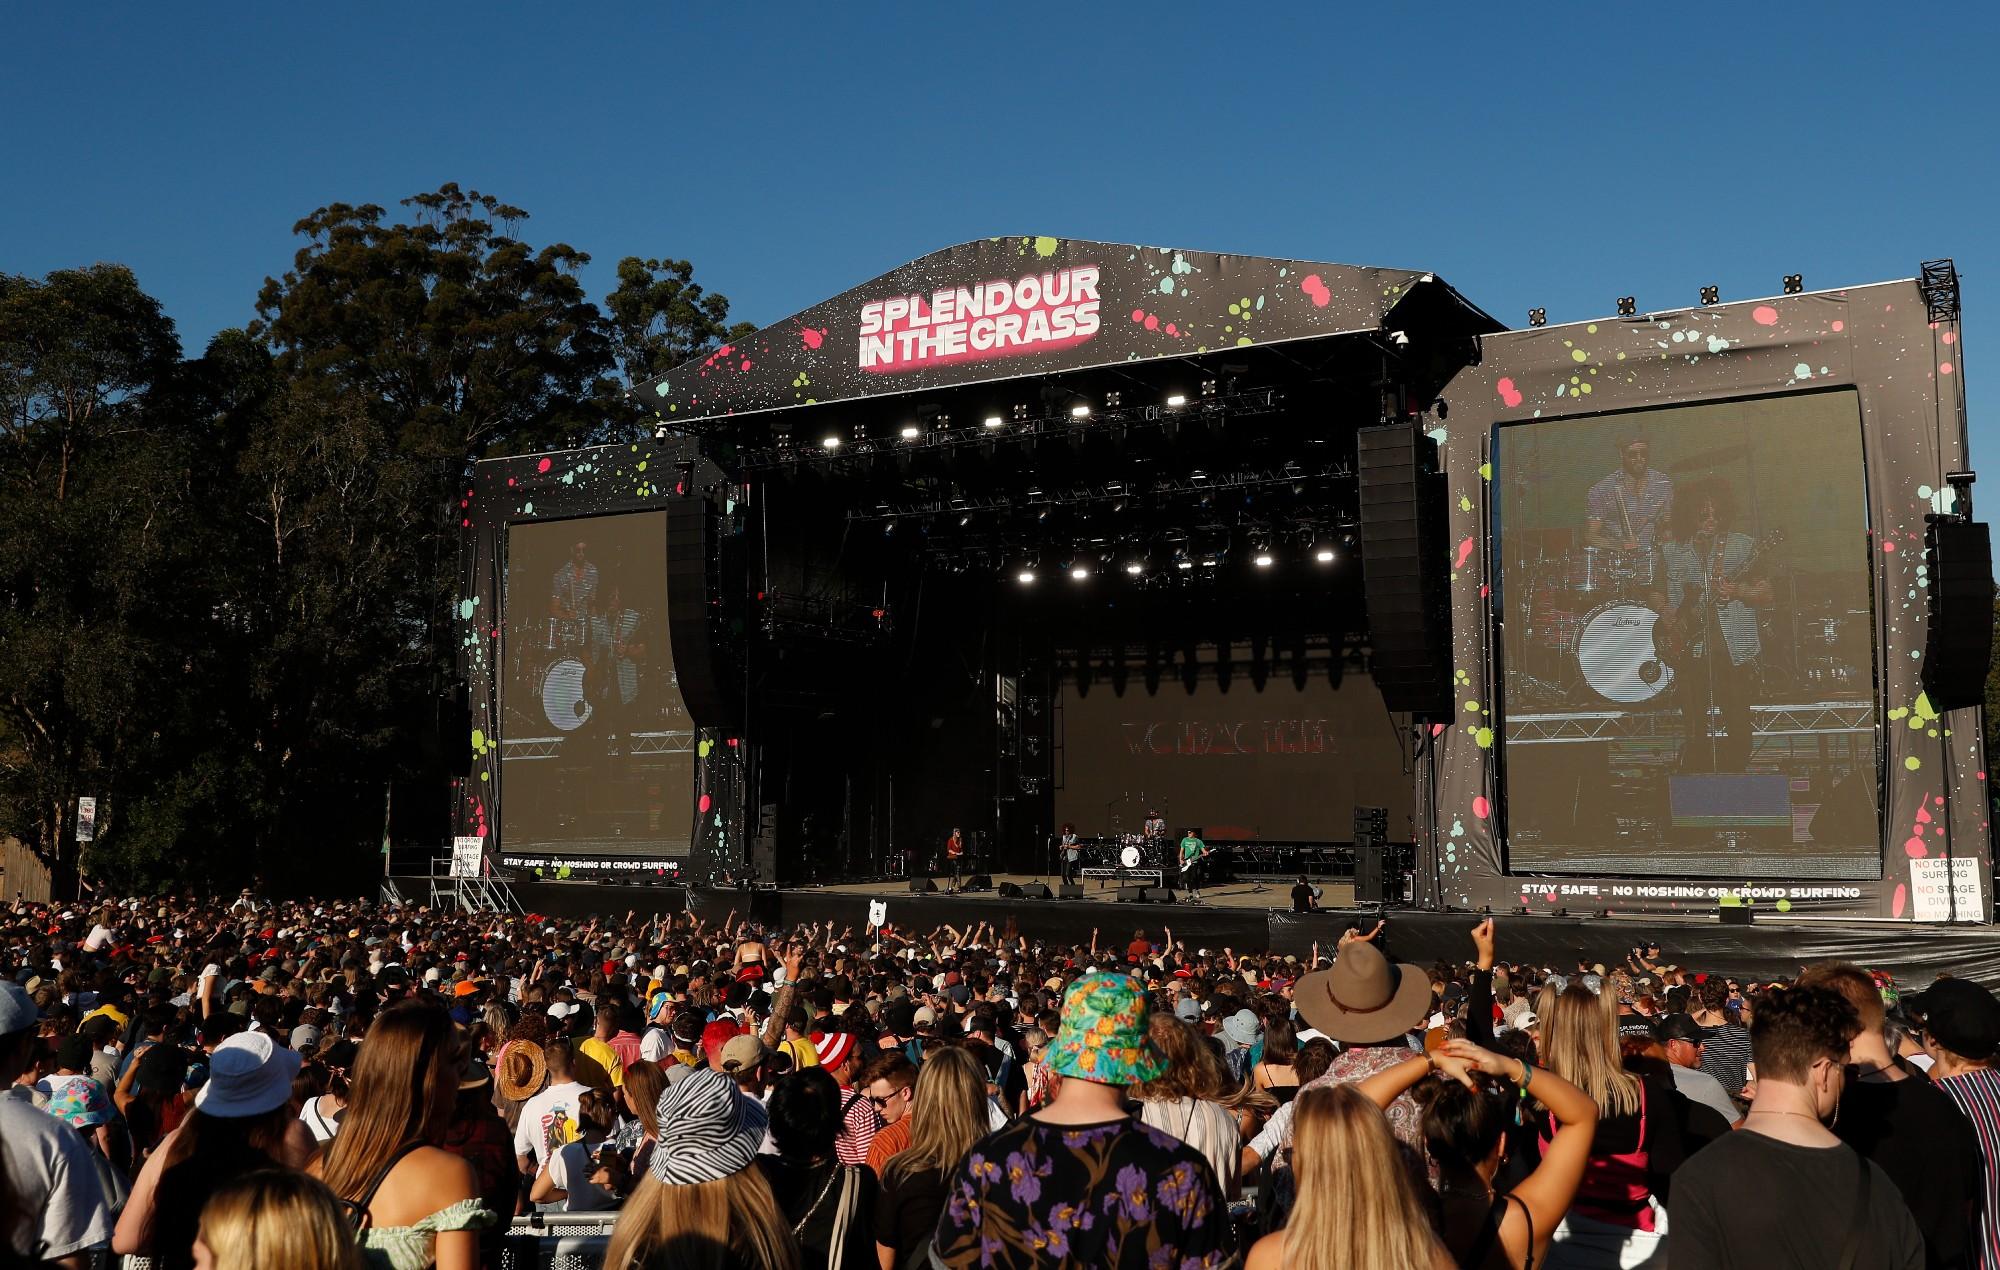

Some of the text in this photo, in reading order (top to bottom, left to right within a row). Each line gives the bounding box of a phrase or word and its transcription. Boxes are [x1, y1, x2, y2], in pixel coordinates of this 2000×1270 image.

[860, 267, 1100, 335] SPLENDOUR
[969, 301, 1100, 349] GRASS
[503, 858, 523, 866] STAY
[524, 859, 544, 867] SAFE
[564, 860, 599, 869] MOSHING
[600, 861, 611, 869] OR
[613, 861, 640, 869] CROWD
[642, 861, 678, 870] SURFING
[1922, 870, 1968, 879] SURFNG
[1521, 884, 1557, 894] STAY
[1561, 885, 1598, 895] SAFE
[1612, 886, 1633, 896] NO
[1637, 886, 1704, 897] MOSHING
[1708, 887, 1729, 897] OR
[1733, 887, 1786, 898] CROWD
[1790, 887, 1861, 898] SURFING
[1917, 886, 1934, 894] NO
[1935, 910, 1982, 919] MOHING
